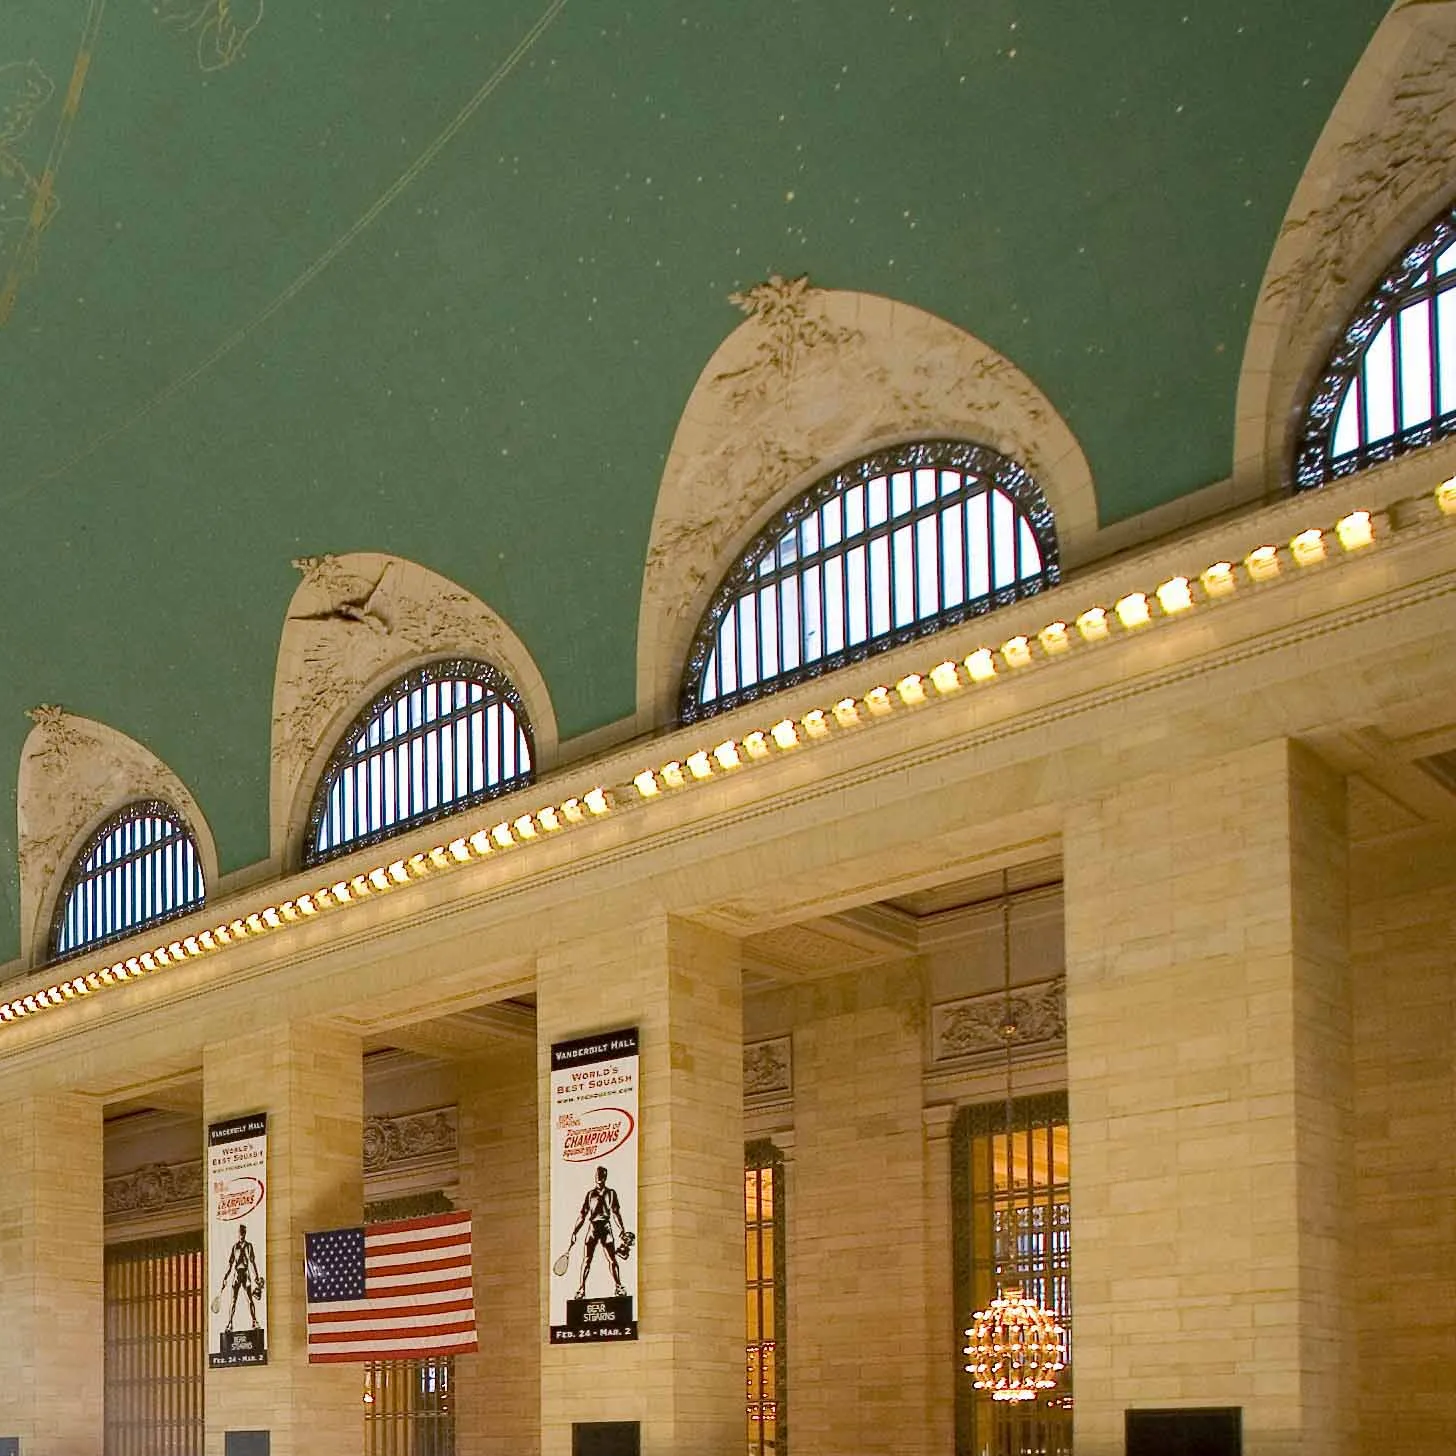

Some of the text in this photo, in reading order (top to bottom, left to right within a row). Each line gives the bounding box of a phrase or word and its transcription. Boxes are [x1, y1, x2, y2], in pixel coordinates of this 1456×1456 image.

[555, 1039, 636, 1060] VANDERBILT HALL
[571, 1065, 619, 1081] WORLD'S
[557, 1075, 632, 1094] BEST SQUASH
[564, 1129, 619, 1148] CHAMPIONS
[579, 1329, 591, 1338] 24
[625, 1327, 632, 1335] 2
